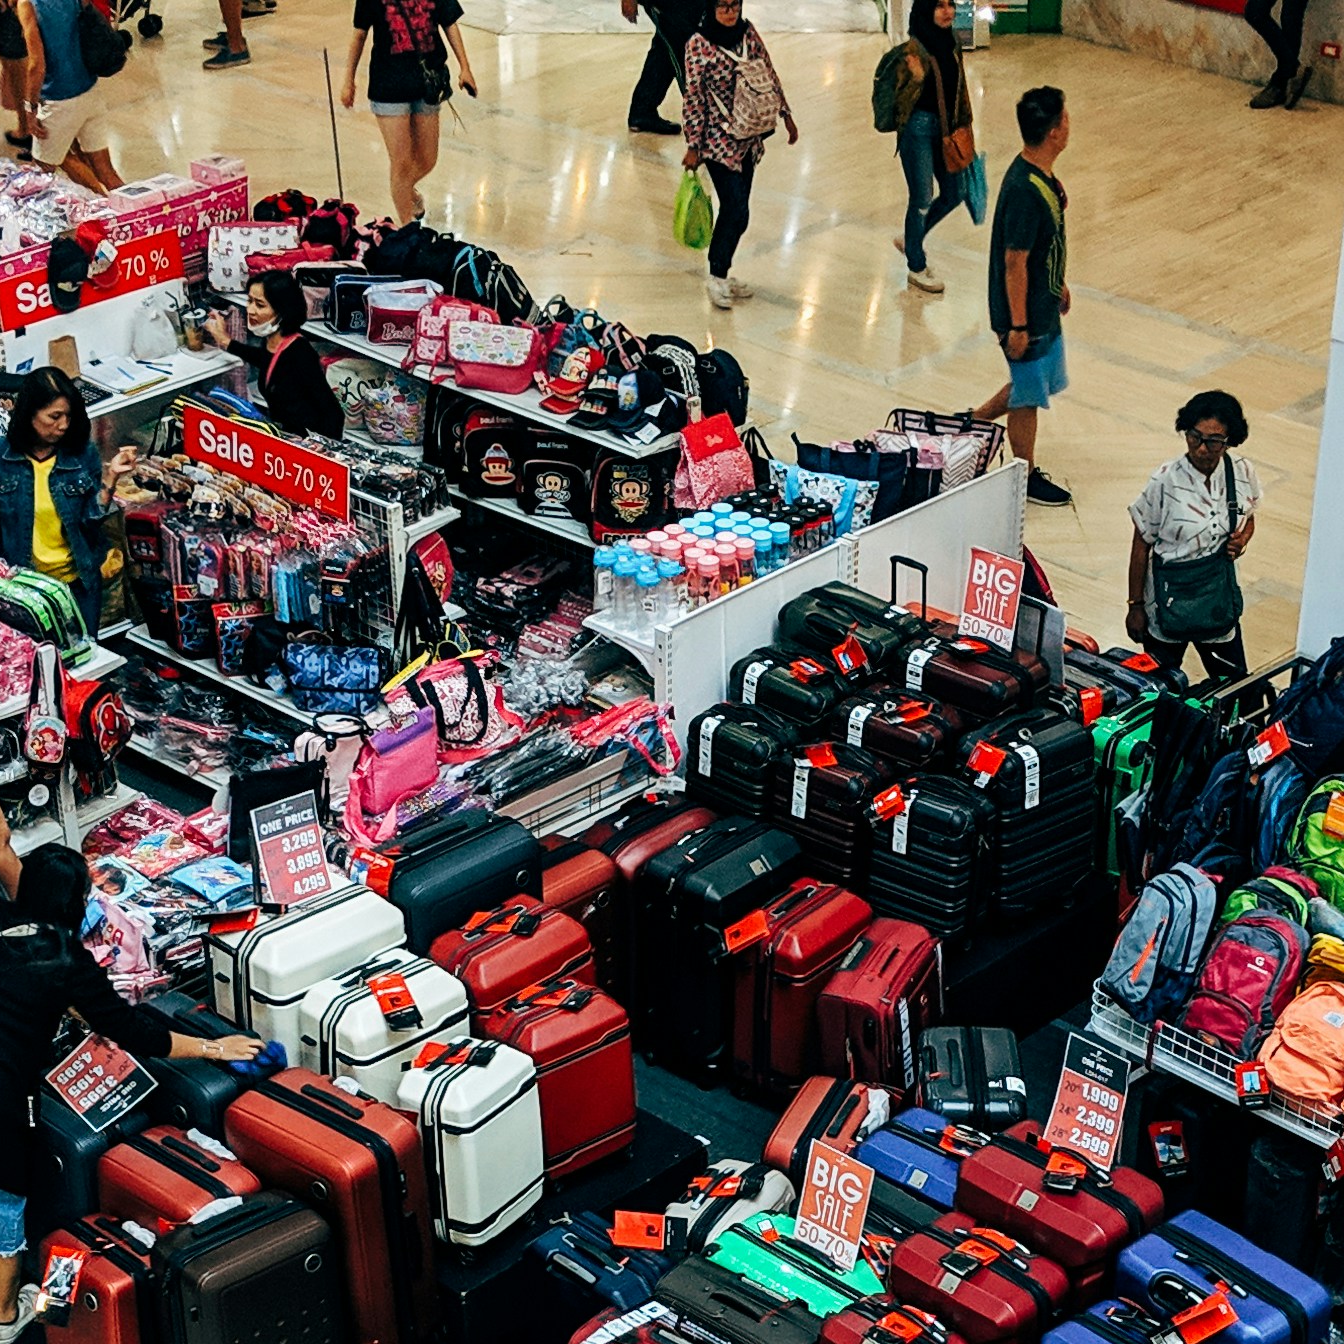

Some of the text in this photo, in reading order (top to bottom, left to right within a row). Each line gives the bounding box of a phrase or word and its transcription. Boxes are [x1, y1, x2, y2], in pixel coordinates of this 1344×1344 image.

[149, 247, 171, 272] %
[198, 419, 336, 502] Sale 50-70 %
[972, 558, 1017, 596] BIG
[972, 586, 1009, 625] SALE
[962, 616, 1010, 646] 50-70%
[259, 808, 315, 836] ONE PRICE
[281, 828, 317, 854] 3,295
[286, 850, 322, 874] 3,895
[293, 871, 327, 896] 4,295
[1081, 1056, 1096, 1069] ONE
[1095, 1062, 1114, 1078] PRICE
[1081, 1082, 1120, 1112] 1,999
[1075, 1105, 1116, 1136] 2,399
[1068, 1127, 1111, 1158] 2,599
[811, 1156, 864, 1204] BIG
[809, 1190, 855, 1237] SALE
[797, 1220, 853, 1263] 50-70%
